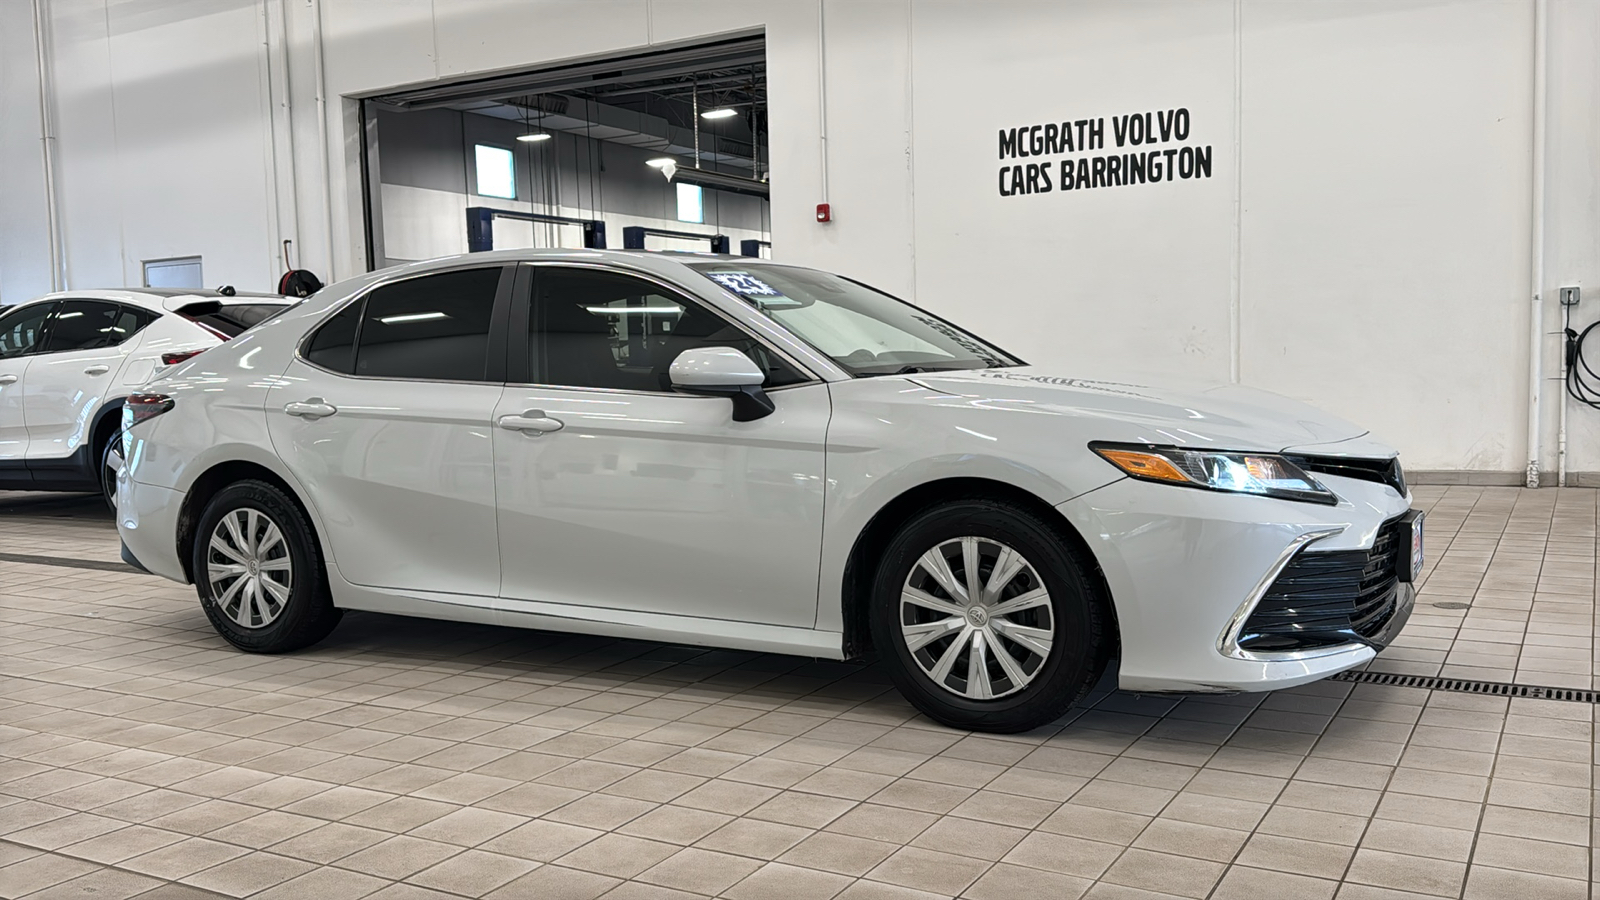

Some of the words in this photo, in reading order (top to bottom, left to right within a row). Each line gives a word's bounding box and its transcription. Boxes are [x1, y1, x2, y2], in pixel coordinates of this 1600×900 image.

[999, 117, 1104, 160] MCGRATH
[1112, 107, 1190, 148] VOLVO
[999, 161, 1053, 197] CARS
[1060, 145, 1212, 191] BARRINGTON
[726, 277, 763, 290] 24
